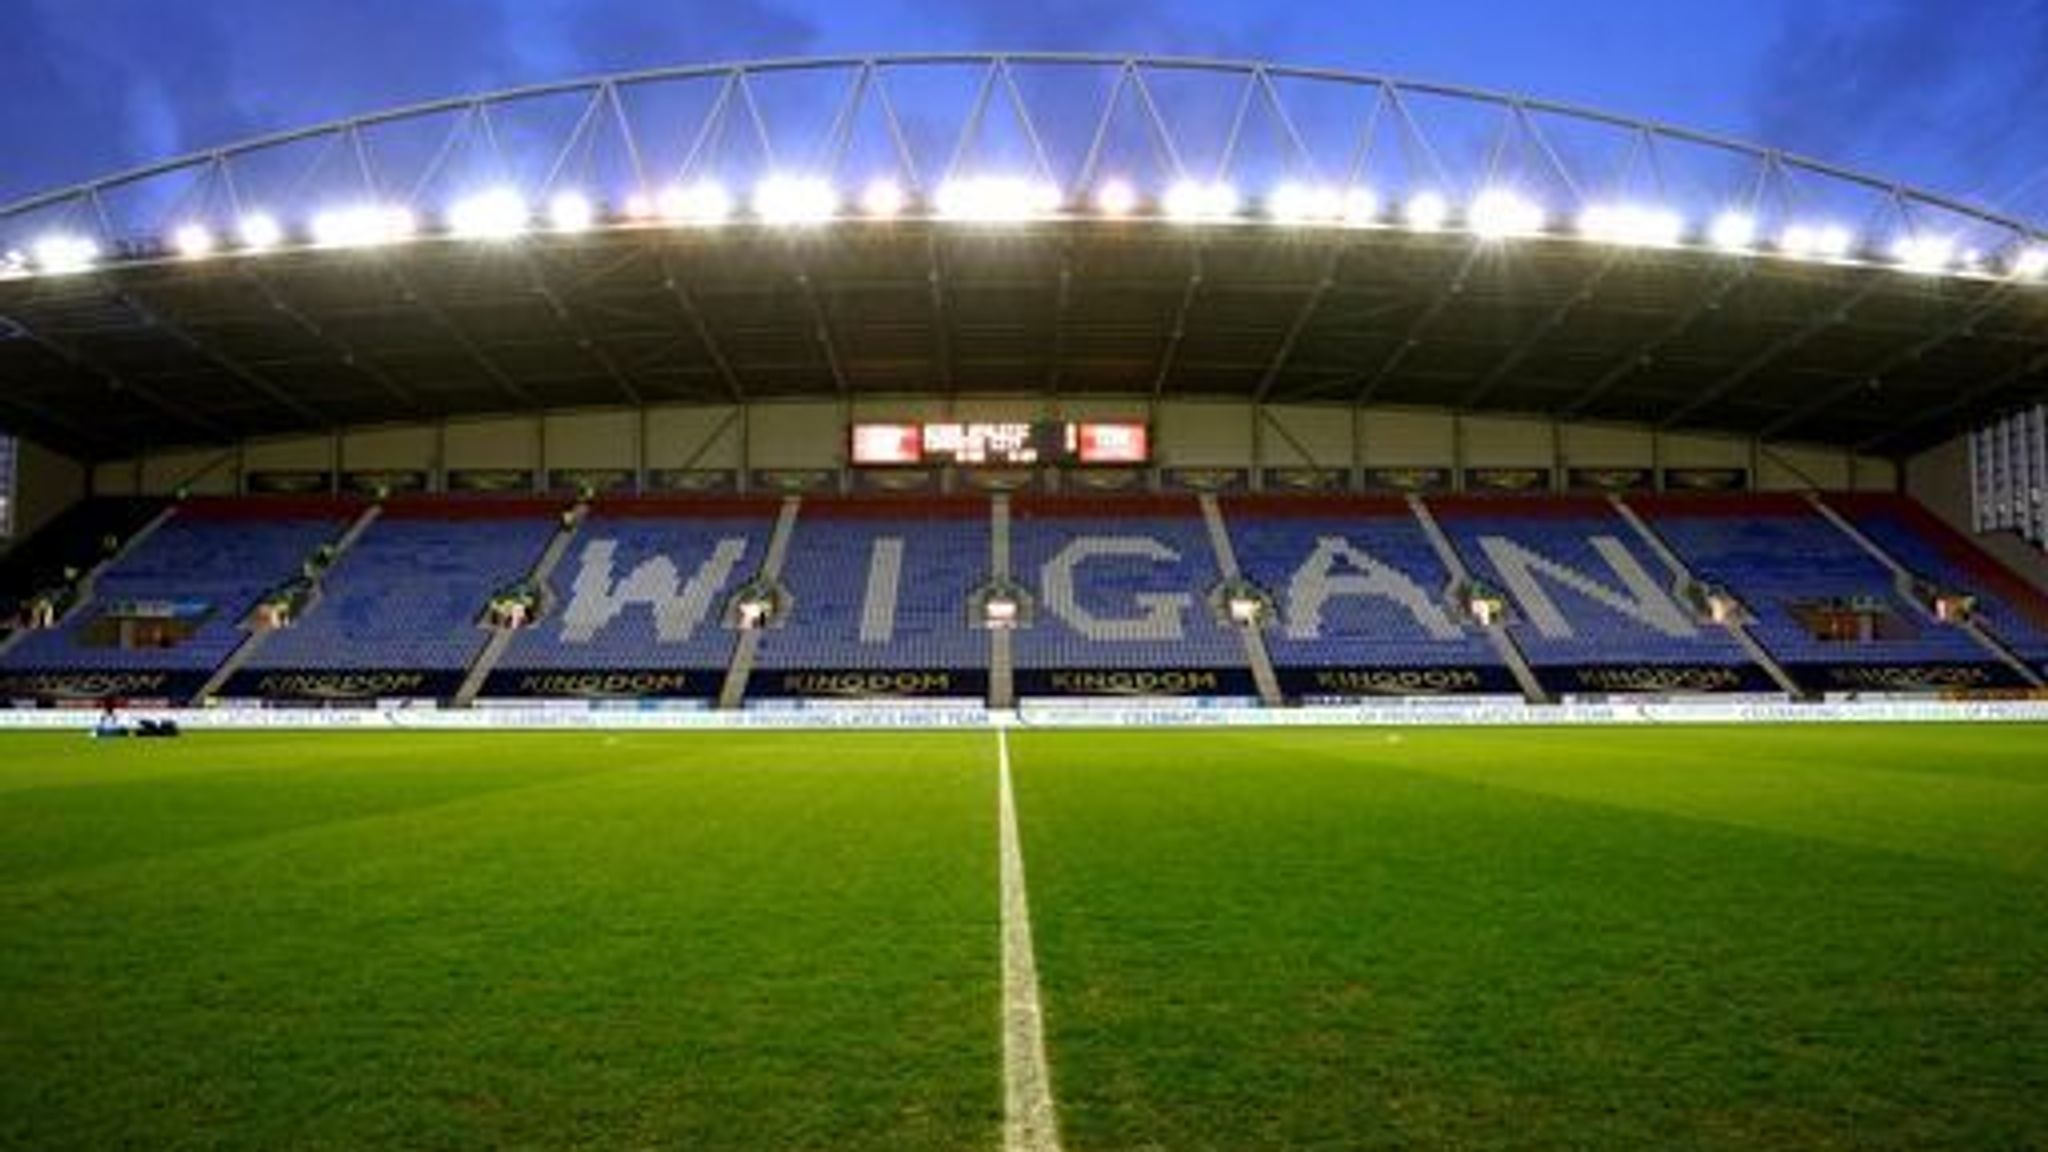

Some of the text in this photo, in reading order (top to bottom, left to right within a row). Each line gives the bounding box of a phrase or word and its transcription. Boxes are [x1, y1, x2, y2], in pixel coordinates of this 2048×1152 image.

[560, 535, 1699, 643] WIGAN
[260, 674, 422, 690] KINGDOM
[521, 674, 685, 690] KINGDOM
[783, 673, 949, 690] KINGDOM
[1051, 672, 1217, 689] KINGDOM
[1316, 671, 1479, 687] KINGDOM
